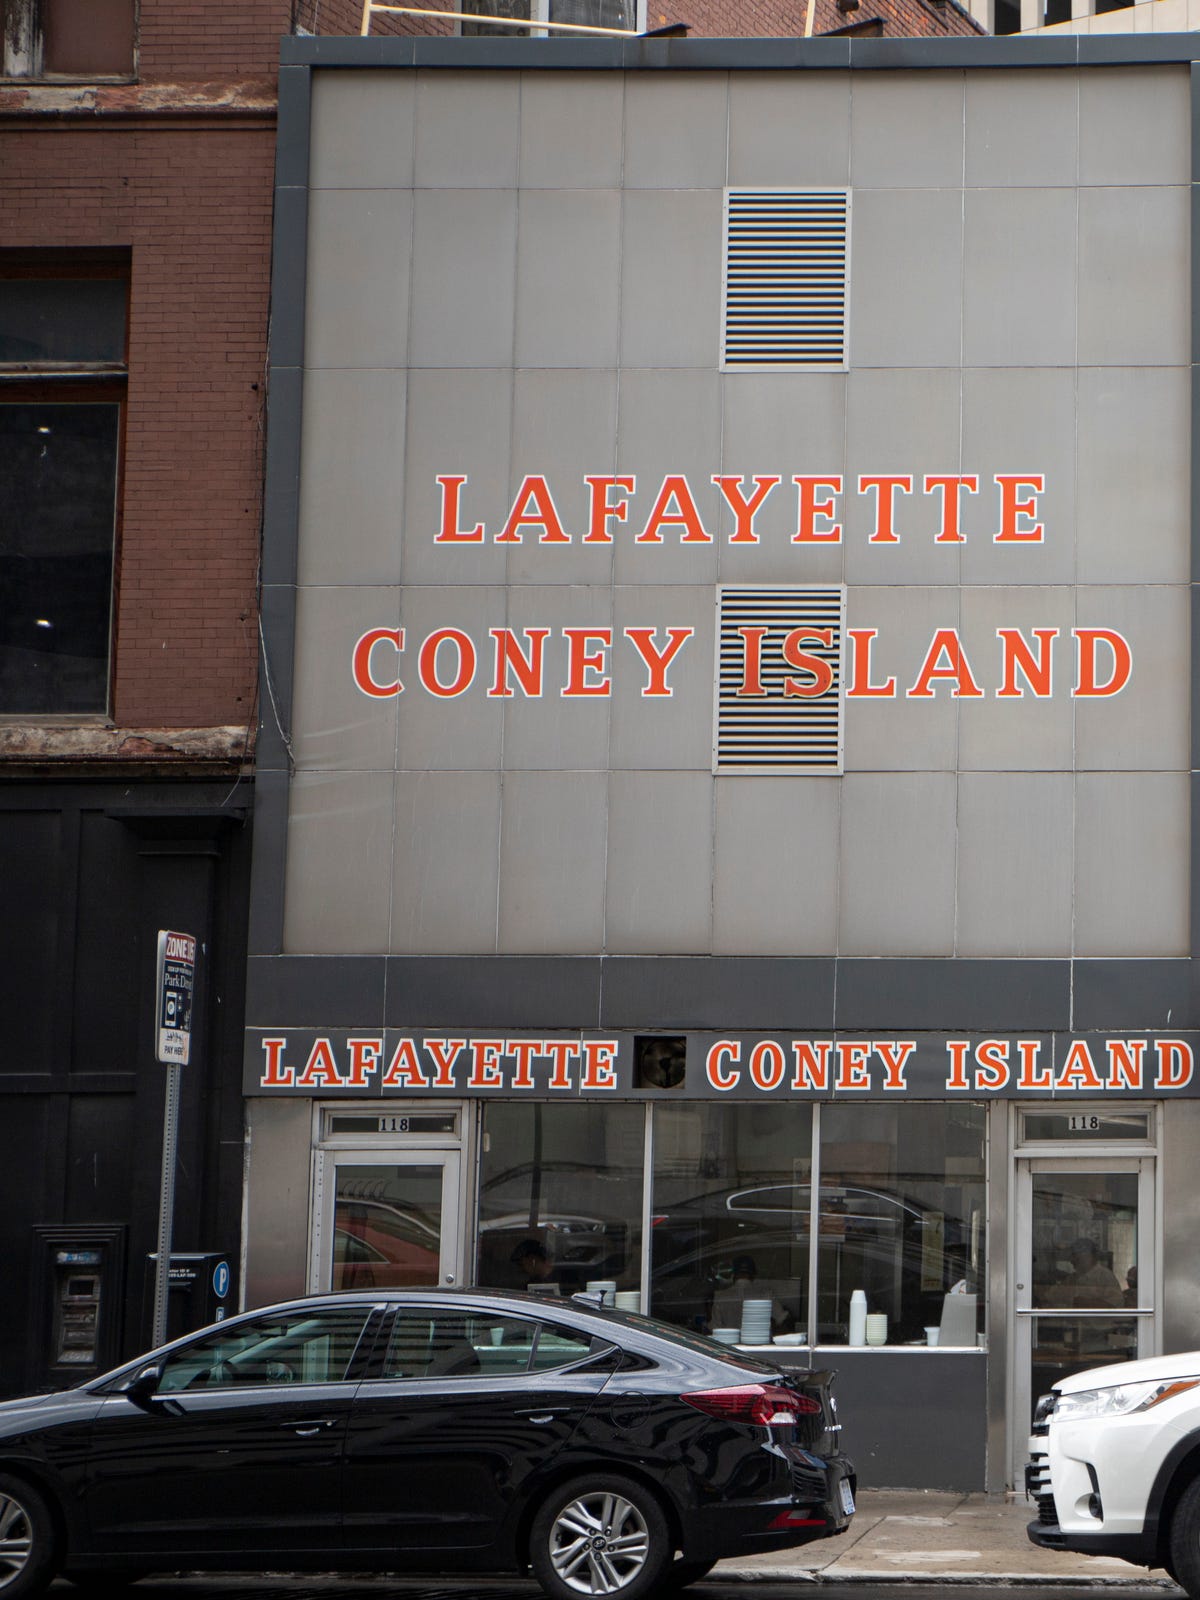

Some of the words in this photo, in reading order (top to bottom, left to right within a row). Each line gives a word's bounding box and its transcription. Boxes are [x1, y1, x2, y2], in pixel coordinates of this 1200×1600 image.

[432, 473, 1046, 545] LAFAYETTE
[352, 626, 695, 700] CONEY
[735, 626, 1133, 700] ISLAND
[167, 937, 187, 958] ZONE
[260, 1037, 619, 1090] LAFAYETTE
[705, 1039, 917, 1092] CONEY
[945, 1039, 1194, 1091] ISLAND
[381, 1118, 408, 1131] 118
[1071, 1116, 1098, 1129] 118
[220, 1268, 227, 1291] P
